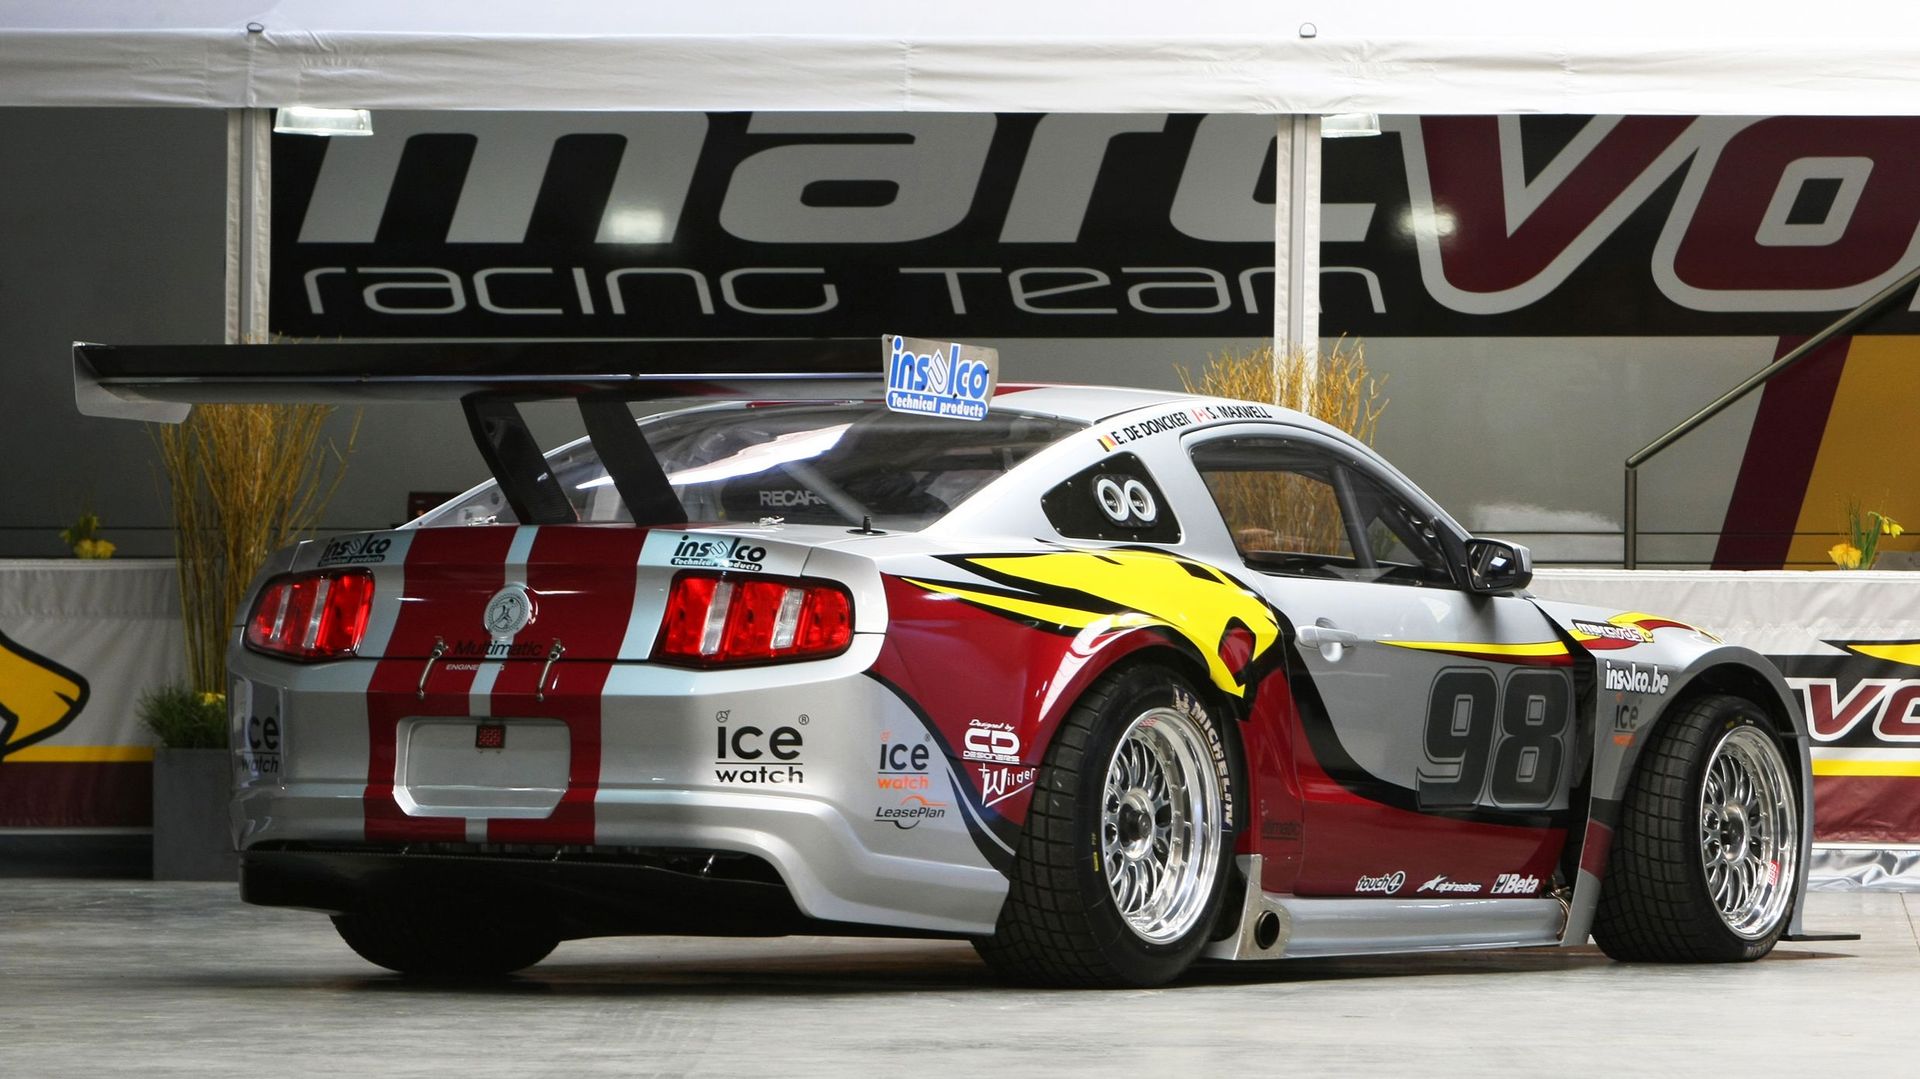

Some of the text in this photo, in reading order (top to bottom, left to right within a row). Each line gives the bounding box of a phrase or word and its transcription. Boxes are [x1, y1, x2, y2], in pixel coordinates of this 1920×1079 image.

[889, 336, 989, 399] insulco
[891, 392, 984, 418] Technical products
[1111, 405, 1273, 445] E. DE DONCKER S. MAXWELL
[759, 490, 828, 506] RECAR
[674, 535, 766, 562] insulco
[454, 640, 543, 656] Multimatic
[1605, 660, 1669, 694] insulco.be
[1615, 705, 1639, 729] ice
[716, 722, 803, 760] ice
[1416, 666, 1572, 811] 98
[879, 743, 930, 771] ice
[1189, 700, 1234, 827] MICHELIN
[715, 766, 803, 784] watch
[877, 776, 929, 790] watch
[875, 805, 945, 818] LeasePlan
[1502, 873, 1540, 894] Beta
